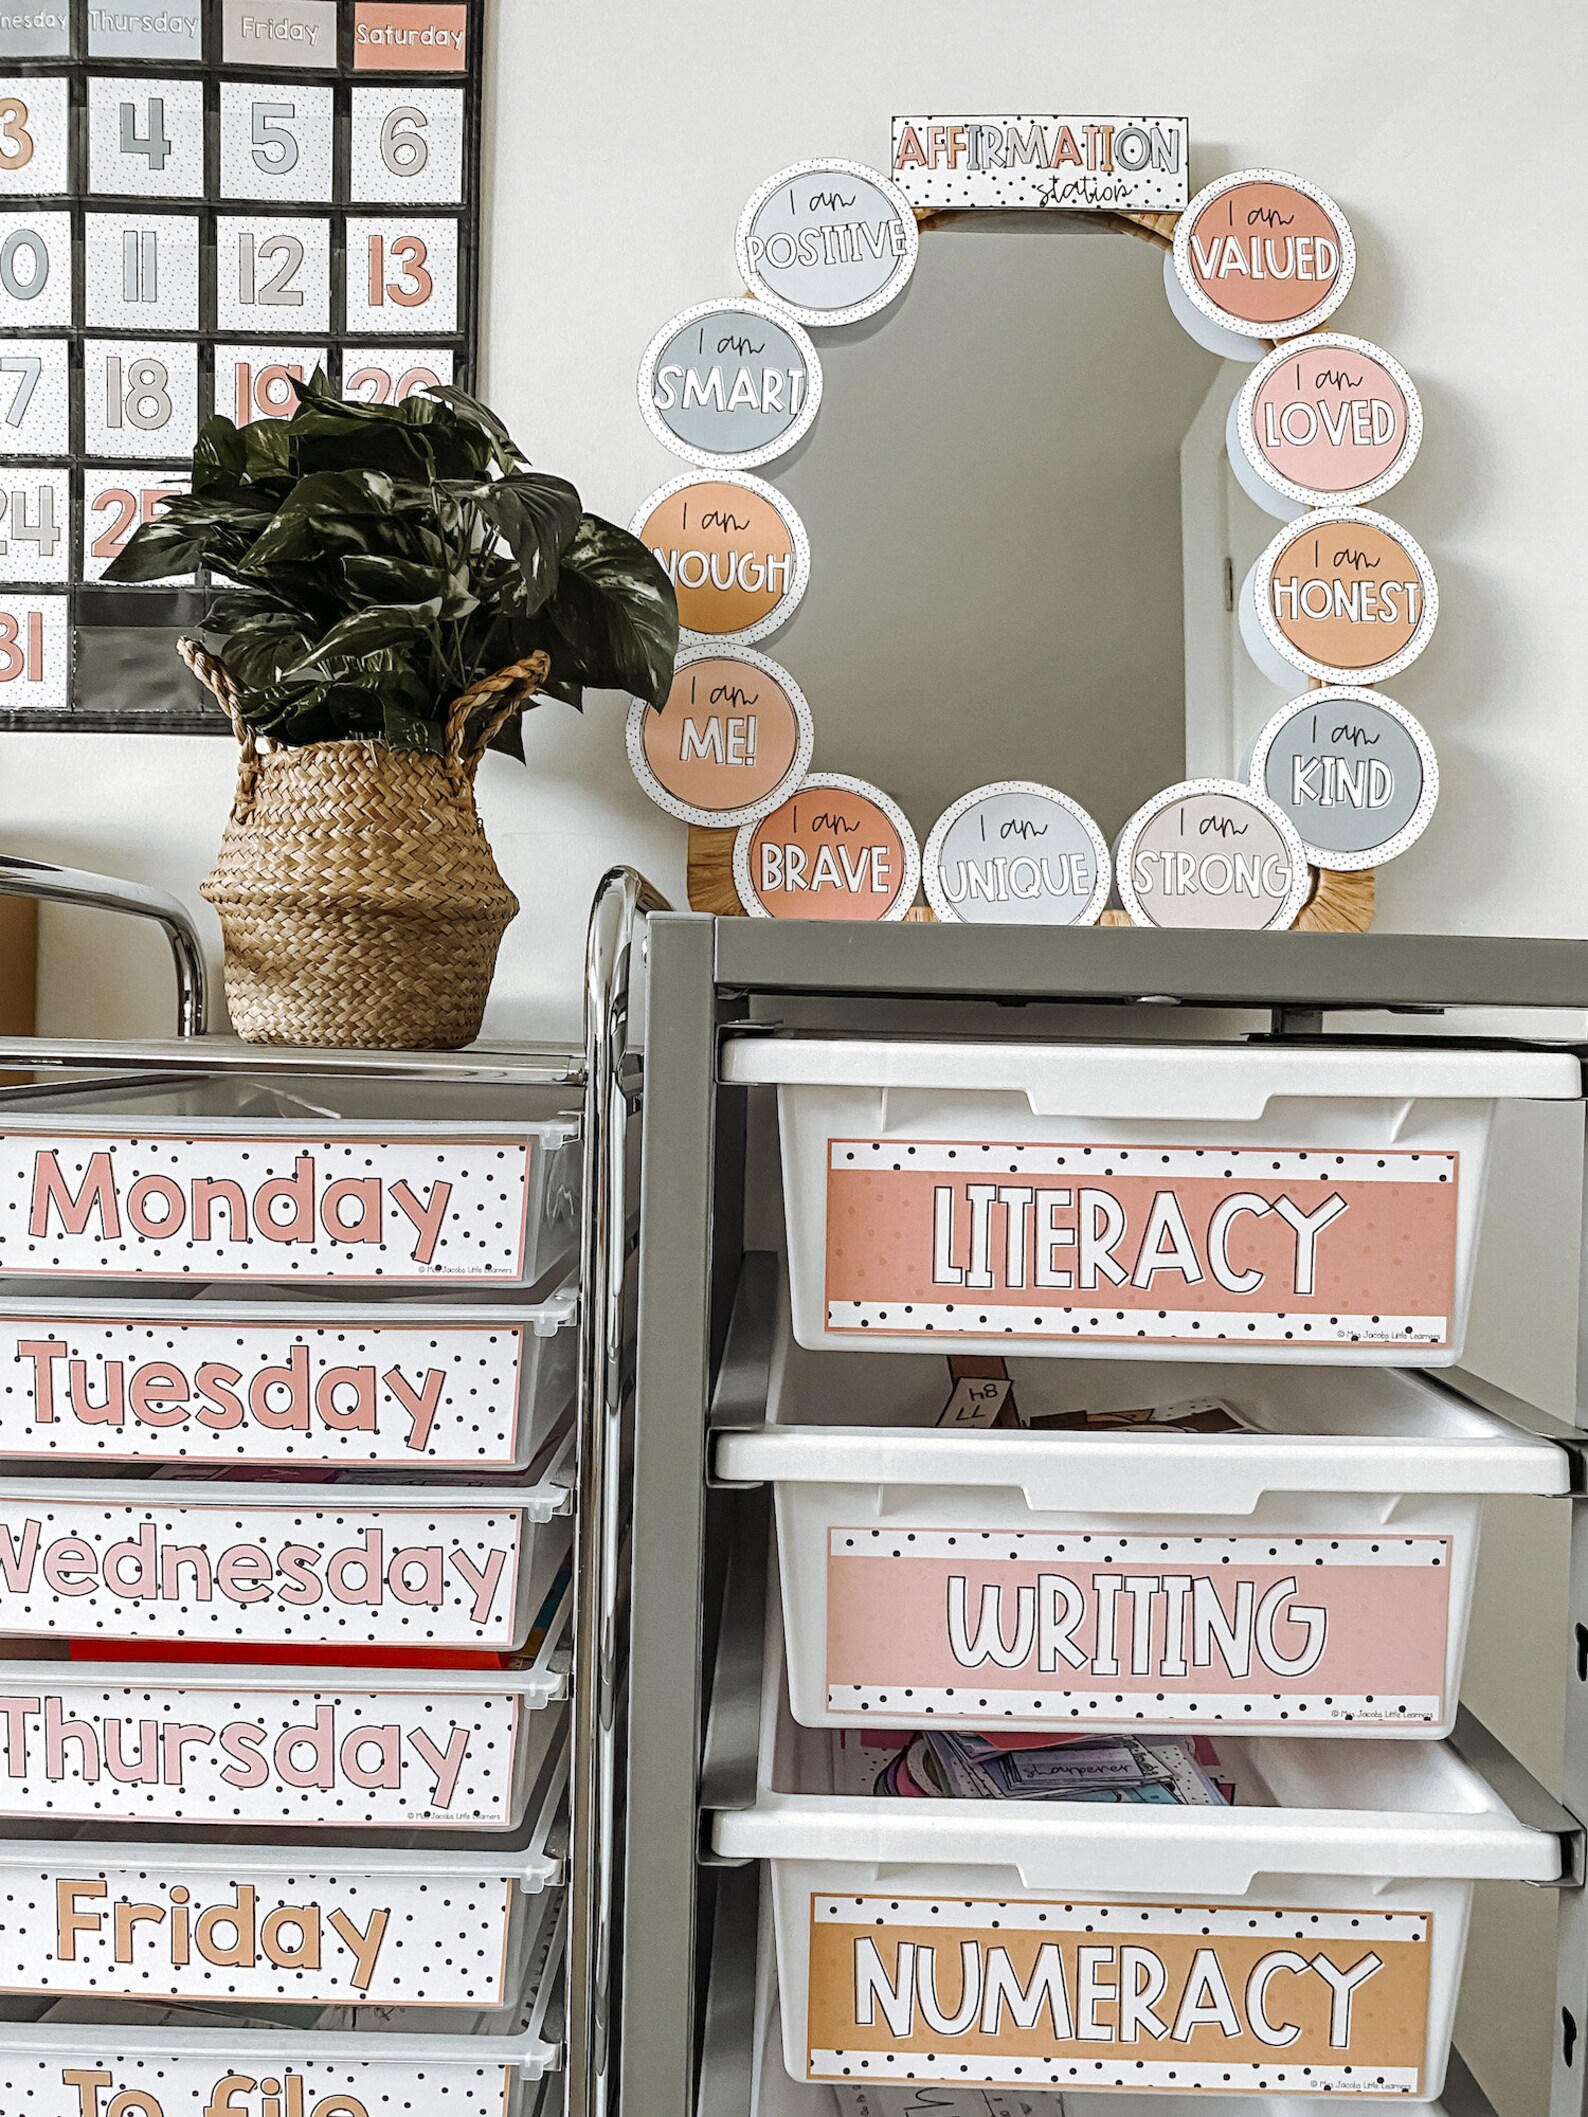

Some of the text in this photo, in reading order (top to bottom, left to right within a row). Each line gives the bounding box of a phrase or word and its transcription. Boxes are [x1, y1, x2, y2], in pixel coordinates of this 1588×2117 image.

[88, 10, 199, 38] Thursday
[241, 16, 319, 46] Friday
[356, 23, 464, 50] Saturday
[0, 97, 34, 170] 3
[119, 97, 171, 170] 4
[251, 102, 298, 175] 5
[380, 106, 428, 177] 6
[894, 124, 1180, 174] AFFIRMATION
[789, 189, 855, 214] I am
[1036, 175, 1133, 204] station
[1228, 200, 1294, 228] I am
[123, 230, 157, 302] 11
[238, 233, 304, 306] 12
[745, 218, 907, 273] POSITIVE
[1190, 235, 1339, 281] VALUED
[368, 235, 433, 307] 13
[698, 328, 766, 356] I am
[106, 356, 172, 430] 18
[235, 363, 303, 430] 19
[652, 365, 805, 415] SMART
[1296, 364, 1363, 391] I am
[1264, 399, 1396, 448] LOVED
[0, 486, 60, 557] 4
[683, 502, 750, 532] I am
[648, 547, 794, 595] NOUGH
[1314, 540, 1380, 571] I am
[1272, 576, 1420, 625] HONEST
[690, 676, 758, 707] I am
[679, 714, 758, 767] ME!
[1311, 715, 1380, 747] I am
[1291, 754, 1394, 809] KIND
[792, 805, 860, 835] I am
[980, 814, 1048, 841] I am
[1179, 807, 1248, 838] I am
[760, 842, 891, 895] BRAVE
[938, 853, 1090, 904] UNIQUE
[1134, 849, 1293, 899] STRONG
[28, 1150, 454, 1264] Monday
[932, 1183, 1348, 1296] LITERACY
[17, 1340, 447, 1452] Tuesday
[946, 1573, 1327, 1679] WRITING
[0, 1695, 470, 1809] Thursday
[55, 1878, 391, 1990] Friday
[853, 1936, 1384, 2048] NUMERACY
